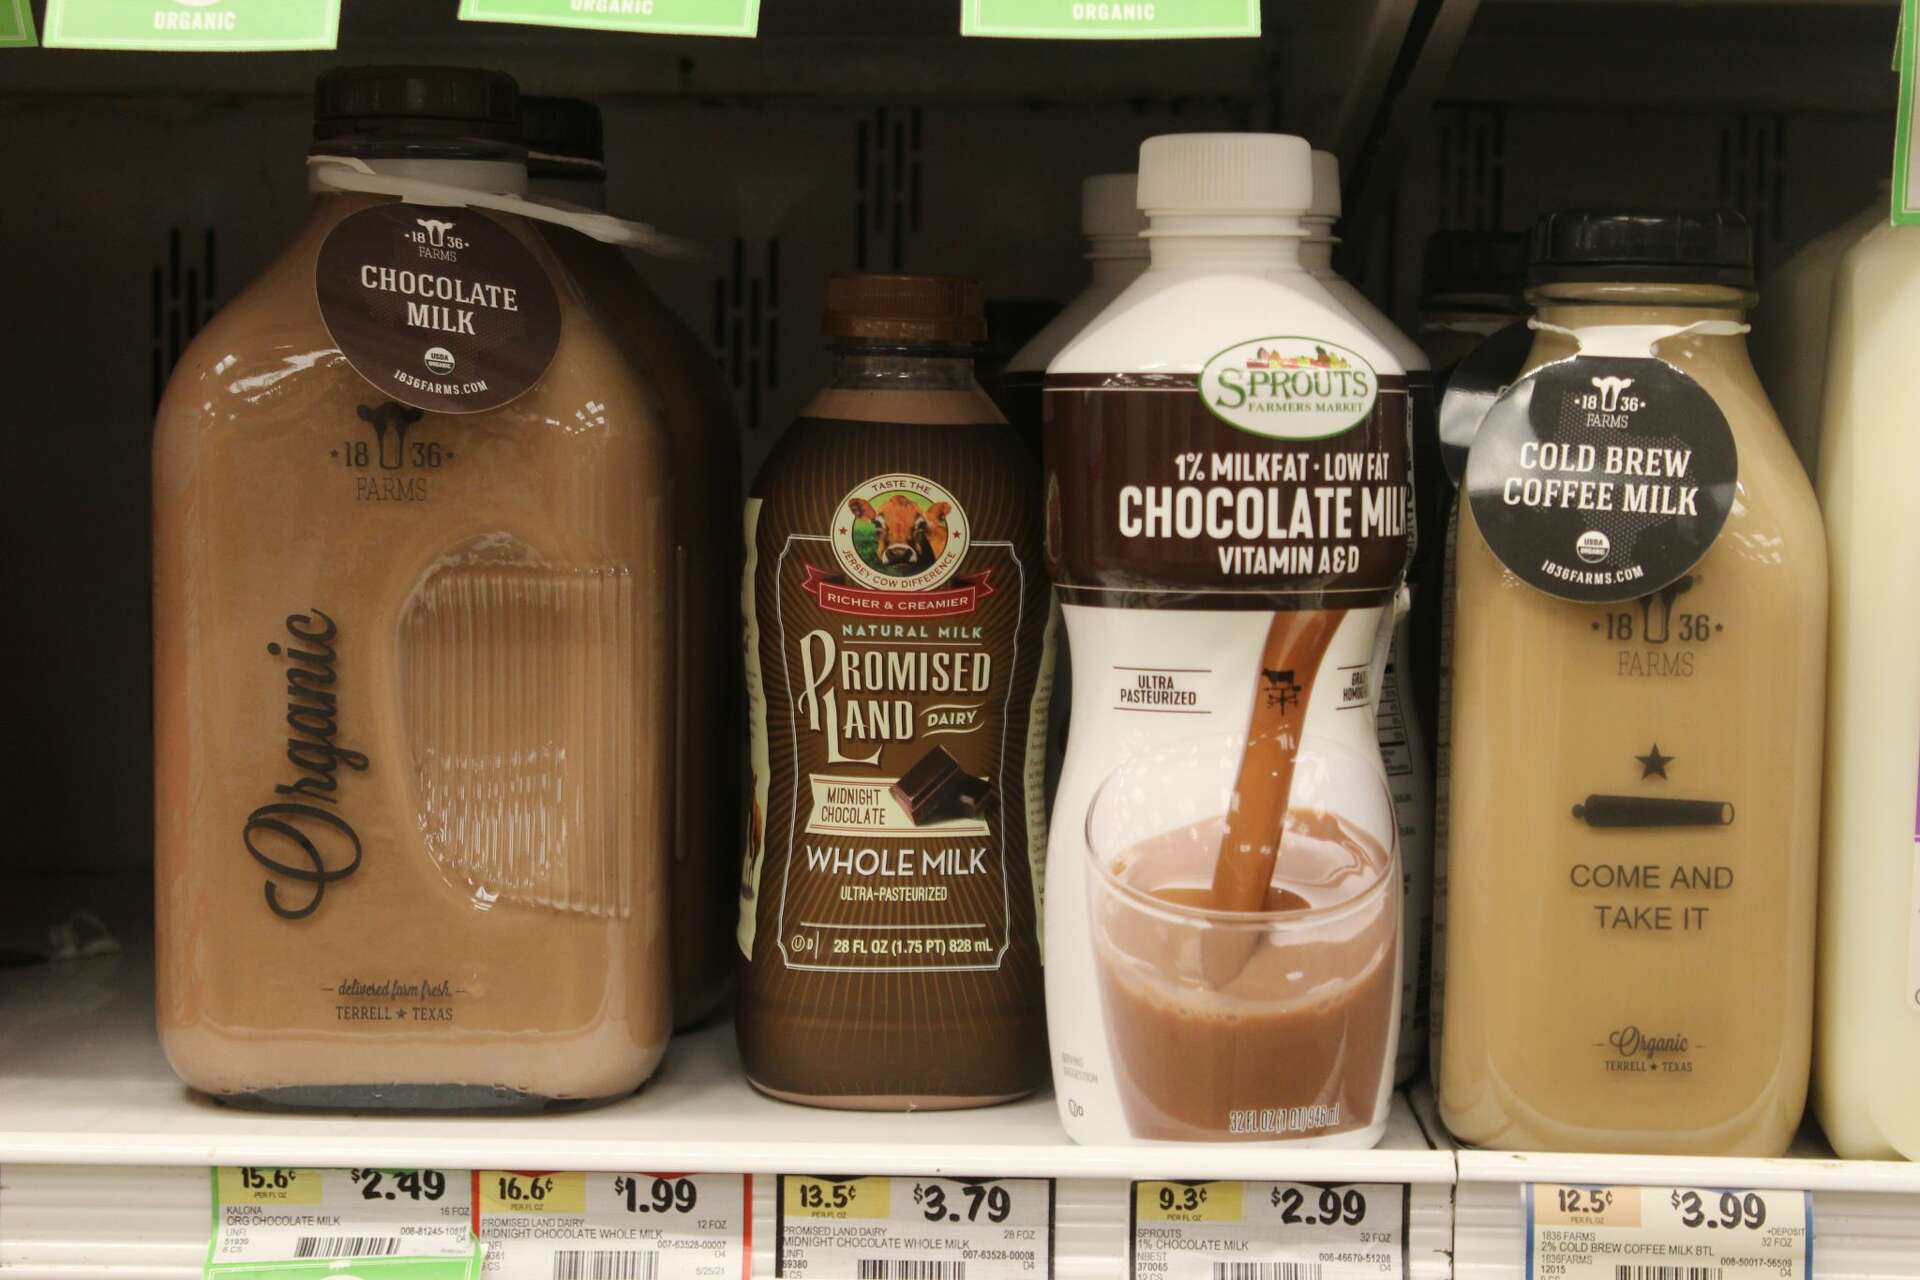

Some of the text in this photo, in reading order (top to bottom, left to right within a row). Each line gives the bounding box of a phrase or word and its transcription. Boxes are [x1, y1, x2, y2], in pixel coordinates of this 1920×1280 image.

[570, 0, 653, 15] ORGANIC
[1072, 3, 1155, 21] ORGANIC
[154, 11, 236, 31] ORGANIC
[419, 246, 457, 262] FARMS
[361, 265, 518, 311] CHOCOLATE
[407, 301, 476, 335] MILK
[430, 352, 449, 361] USDA
[394, 369, 488, 396] 1836FARMS.COM
[1216, 367, 1369, 409] SPROUTS
[1248, 402, 1364, 413] FARMERS MARKET
[1586, 413, 1629, 429] FARMS
[1174, 453, 1391, 482] 1% MILKFAT LOW FAT
[1519, 442, 1692, 478] COLD BREW
[352, 476, 428, 502] FARMS
[872, 480, 931, 494] TASTE THE
[1502, 477, 1700, 517] COFFEE MILK
[1118, 486, 1353, 539] CHOCOLATE
[1583, 538, 1603, 546] USDA
[842, 550, 957, 589] JERSEY COW DIFFERENCE
[1218, 546, 1360, 576] VITAMIN A&D
[1541, 559, 1645, 585] 1836FARMS.COM
[827, 593, 969, 611] RICHER & CREAMIER
[842, 624, 983, 640] NATURAL MILK
[1616, 651, 1695, 677] FARMS
[799, 629, 991, 731] PROMISED
[1137, 675, 1174, 690] ULTRA
[1120, 689, 1197, 706] PASTEURIZED
[822, 686, 978, 767] LAND DAIRY
[243, 607, 370, 920] Organic
[827, 788, 881, 806] MIDNIGHT
[821, 805, 887, 826] CHOCOLATE
[805, 845, 987, 877] WHOLE MILK
[1569, 864, 1734, 890] COME AND
[840, 886, 948, 902] ULTRA-PASTEURIZED
[1593, 905, 1710, 930] TAKE IT
[833, 938, 994, 957] 28 FL OZ (1.75 PT) 828 mL
[338, 978, 449, 1000] delivered farm fresh
[336, 1006, 453, 1021] TERRELL TEXAS
[1609, 1026, 1689, 1059] Organic
[1605, 1061, 1693, 1072] TERRELL TEXAS
[1229, 1110, 1244, 1133] 32
[1245, 1110, 1258, 1133] FL
[1260, 1109, 1276, 1132] OZ
[241, 1167, 297, 1189] 15.6¢
[351, 1168, 446, 1201] $2.49
[254, 1191, 268, 1199] PER
[498, 1177, 553, 1201] 16.6¢
[614, 1176, 698, 1213] $1.99
[800, 1184, 857, 1209] 13.5¢
[913, 1183, 1012, 1223] $3.79
[1159, 1187, 1208, 1211] 9.3¢
[1271, 1186, 1367, 1226] $2.99
[1558, 1189, 1613, 1214] 12.5¢
[226, 1206, 263, 1215] KALONA
[440, 1207, 470, 1216] 16 FOZ
[836, 1211, 847, 1219] OZ
[1671, 1188, 1767, 1230] $3.99
[226, 1216, 340, 1226] ORG CHOCOLATE MILK
[482, 1218, 584, 1228] PROMISED LAND DAIRY
[697, 1220, 727, 1230] 12 FOZ
[1570, 1216, 1584, 1224] PER
[482, 1228, 663, 1239] MIDNIGHT CHOCOLATE WHOLE MILK
[784, 1226, 887, 1237] PROMISED LAND DAIRY
[1003, 1230, 1036, 1240] 28 FOZ
[1137, 1228, 1182, 1238] SPROUTS
[1359, 1232, 1391, 1243] 32 FOZ
[1541, 1231, 1596, 1241] 1836 FARMS
[784, 1236, 970, 1249] MIDNIGHT CHOCOLATE WHOLE MILK
[1138, 1239, 1249, 1251] 1% CHOCOLATE MILK
[1541, 1242, 1714, 1256] 2% COLD BREW COFFEE MILK BTL
[1761, 1237, 1792, 1247] 32 FOZ
[1137, 1252, 1166, 1261] NBEST
[1541, 1255, 1592, 1265] 1836FARMS
[1137, 1262, 1168, 1272] 370065
[1541, 1265, 1566, 1274] 12015
